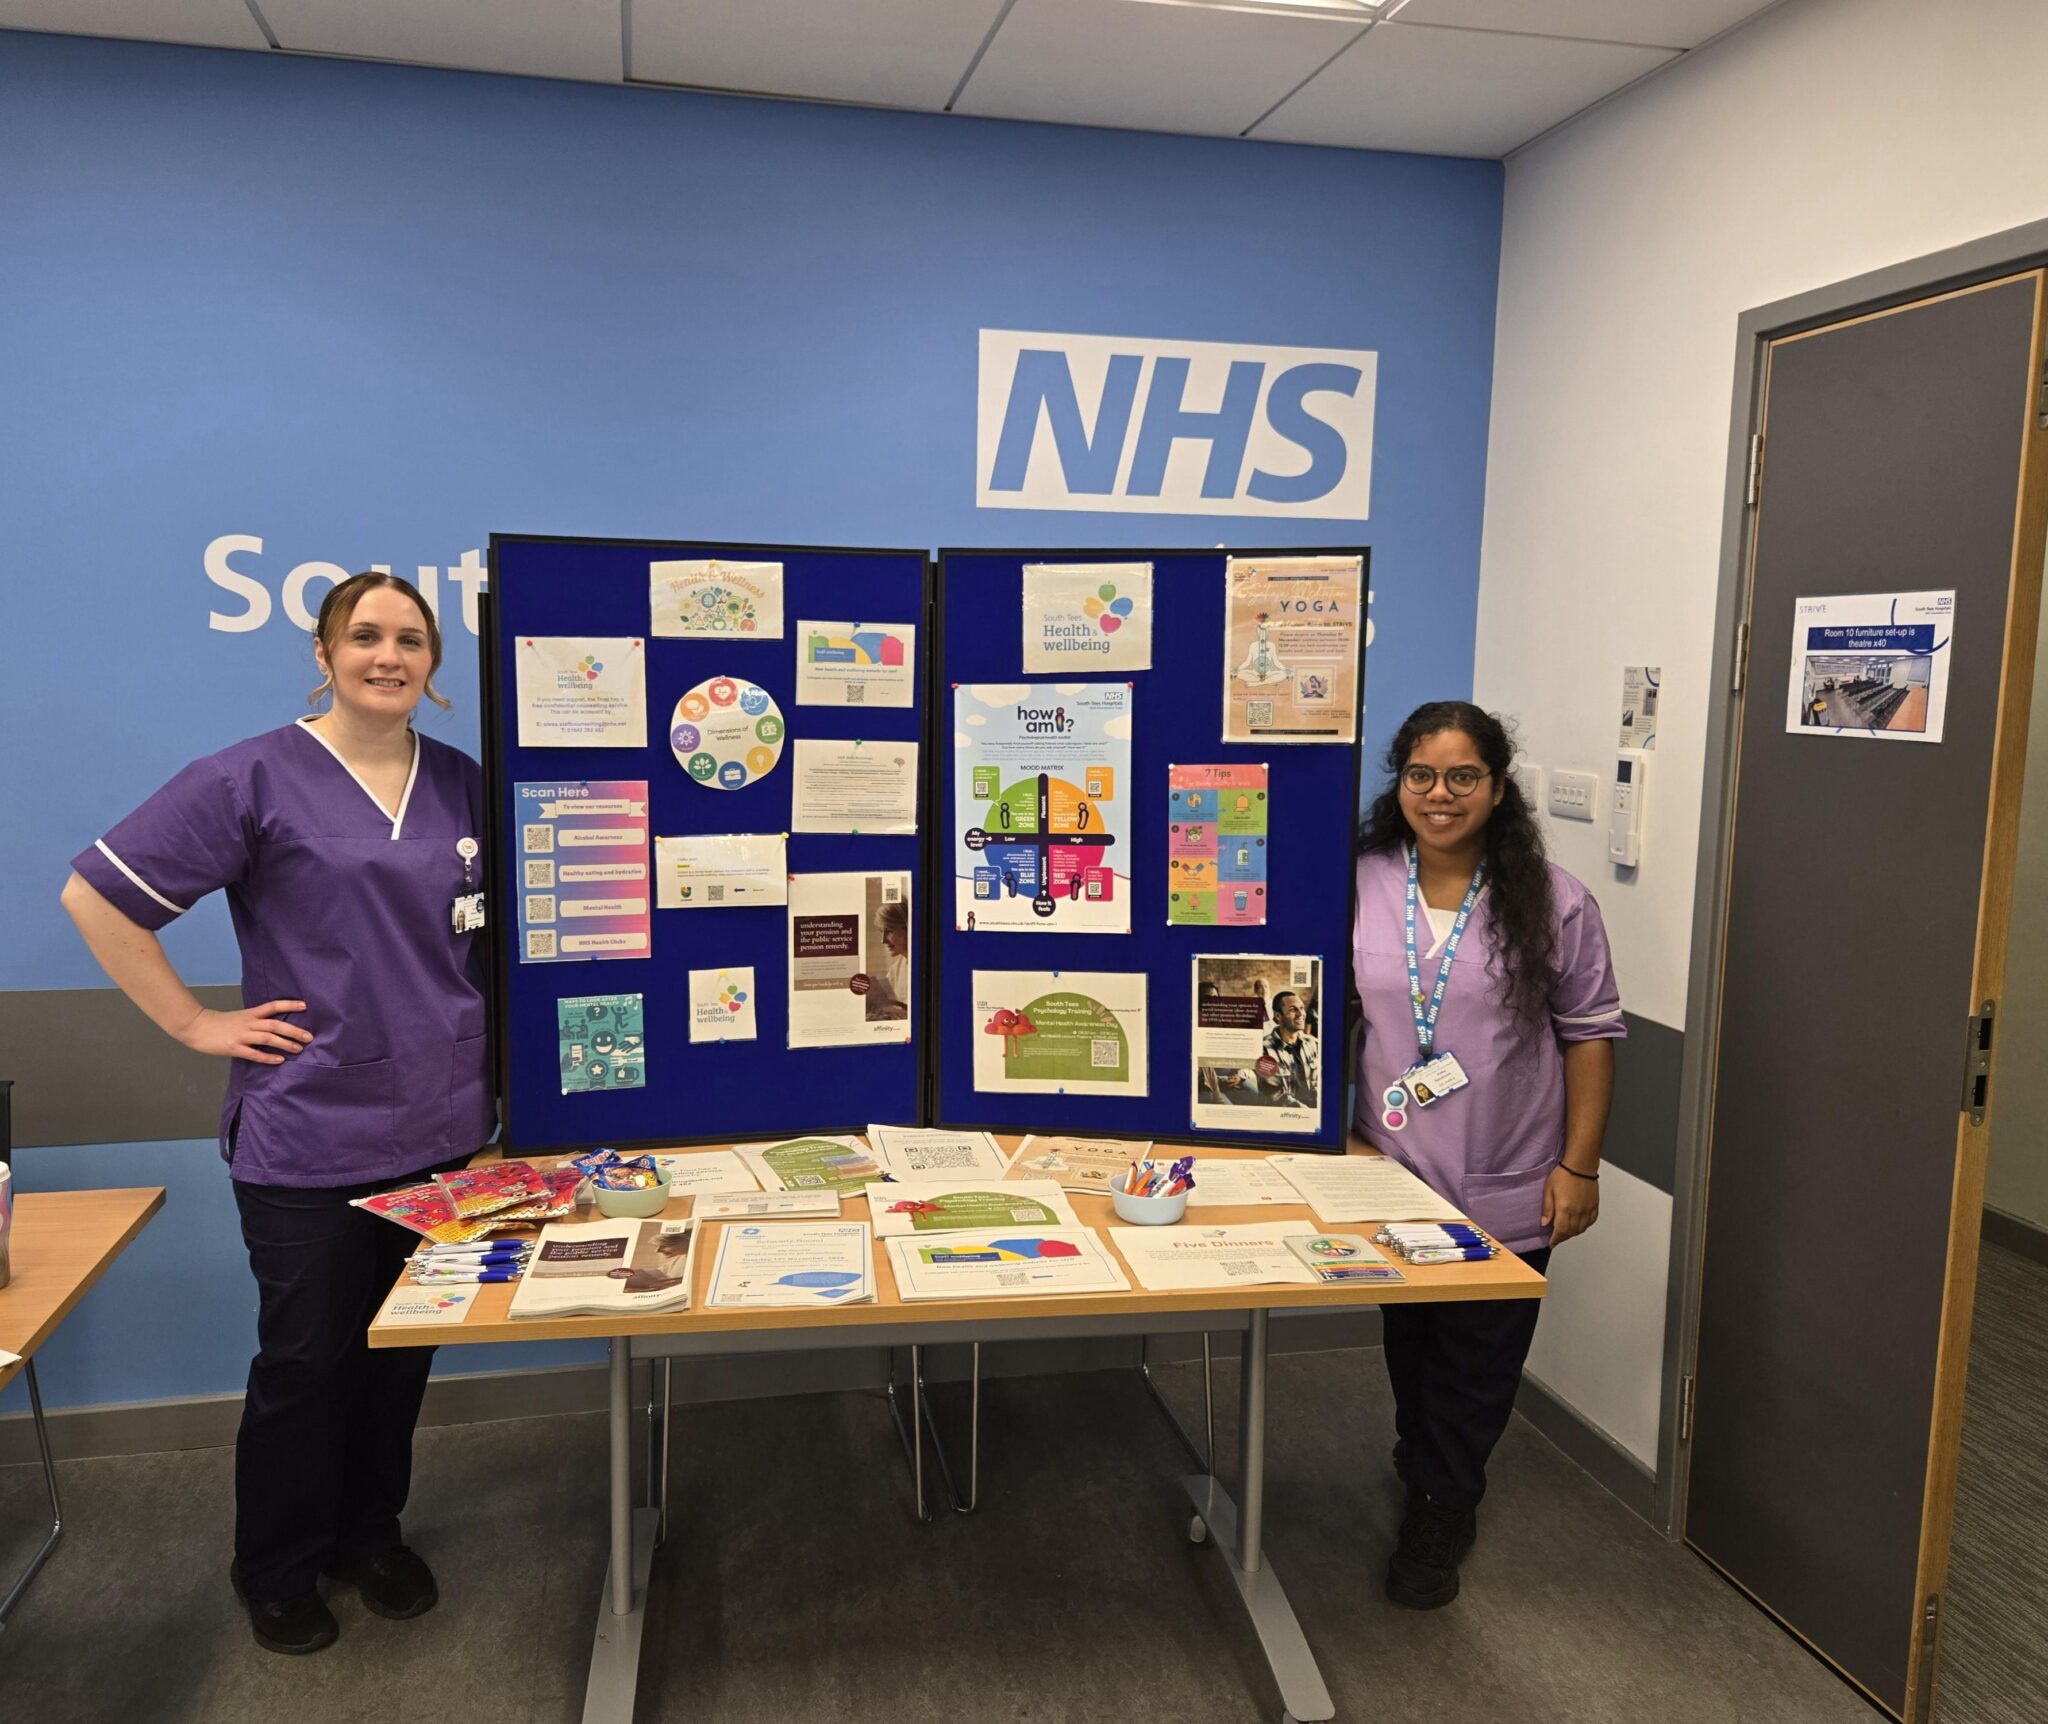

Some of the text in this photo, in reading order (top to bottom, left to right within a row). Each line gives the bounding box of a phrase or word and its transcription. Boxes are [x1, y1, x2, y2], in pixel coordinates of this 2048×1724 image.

[989, 348, 1363, 503] NHS
[719, 570, 766, 598] Wellness
[1280, 600, 1339, 612] YOGA
[1799, 604, 1827, 614] STRIVE
[1043, 614, 1064, 622] South
[1043, 624, 1091, 637] Health
[1824, 629, 1844, 637] Room
[1855, 628, 1883, 637] furniture
[1885, 628, 1908, 638] set-up
[1909, 627, 1915, 636] is
[1043, 638, 1110, 654] wellbeing
[1848, 639, 1887, 648] theatre x40
[558, 682, 593, 690] wellbeing
[1105, 692, 1123, 700] NHS
[1017, 705, 1054, 720] how
[707, 727, 741, 735] Dimensions
[1025, 722, 1054, 733] am
[1205, 769, 1232, 779] 7 Tips
[521, 787, 589, 798] Scan Here
[1408, 863, 1417, 879] NHS
[1472, 870, 1483, 888] NHS
[1407, 883, 1416, 900] NHS
[1463, 890, 1476, 908] NHS
[1406, 904, 1415, 921] NHS
[800, 920, 844, 928] understanding
[1455, 911, 1469, 930] NHS
[800, 929, 815, 937] your
[816, 928, 839, 936] pension
[1406, 926, 1415, 944] NHS
[812, 935, 830, 944] public
[1447, 933, 1460, 952] NHS
[800, 944, 824, 952] pension
[1408, 950, 1417, 969] NHS
[1440, 955, 1453, 976] NHS
[1433, 980, 1446, 1001] NHS
[696, 1008, 724, 1016] Health
[1067, 1008, 1093, 1016] Training
[1426, 1004, 1439, 1025] NHS
[697, 1014, 736, 1024] wellbeing
[873, 1025, 893, 1033] affinity
[1417, 1025, 1428, 1045] NHS
[1073, 1145, 1128, 1156] YOGA
[1172, 1239, 1275, 1250] Five Dinners
